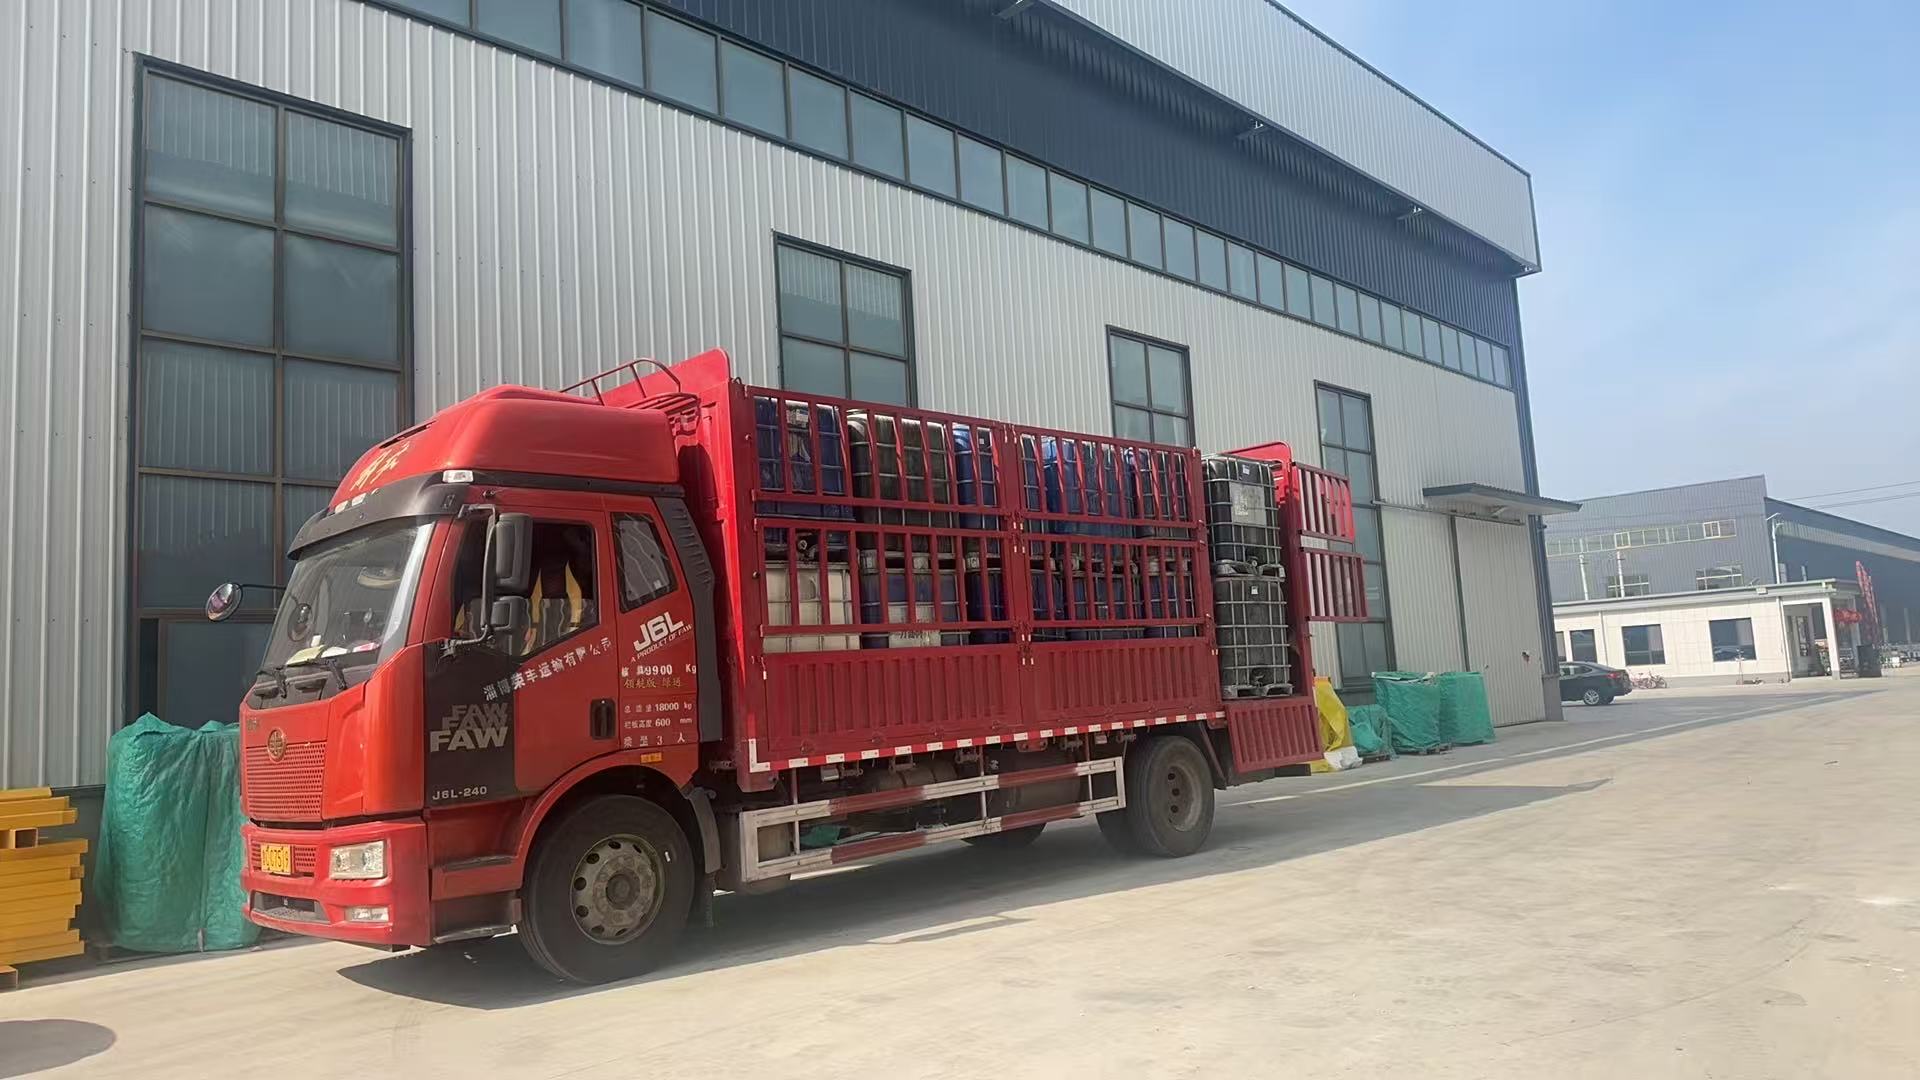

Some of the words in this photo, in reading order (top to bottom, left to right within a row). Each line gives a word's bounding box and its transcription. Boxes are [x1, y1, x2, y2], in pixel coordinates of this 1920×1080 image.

[633, 611, 685, 653] J6L
[637, 638, 668, 660] PRODUCT
[644, 664, 673, 676] 9900
[685, 663, 697, 674] Kg
[654, 702, 680, 712] 18000
[655, 718, 672, 727] 600
[429, 726, 509, 752] FAW
[656, 735, 664, 746] 3
[677, 732, 687, 744] 人
[432, 786, 488, 800] J6L-240
